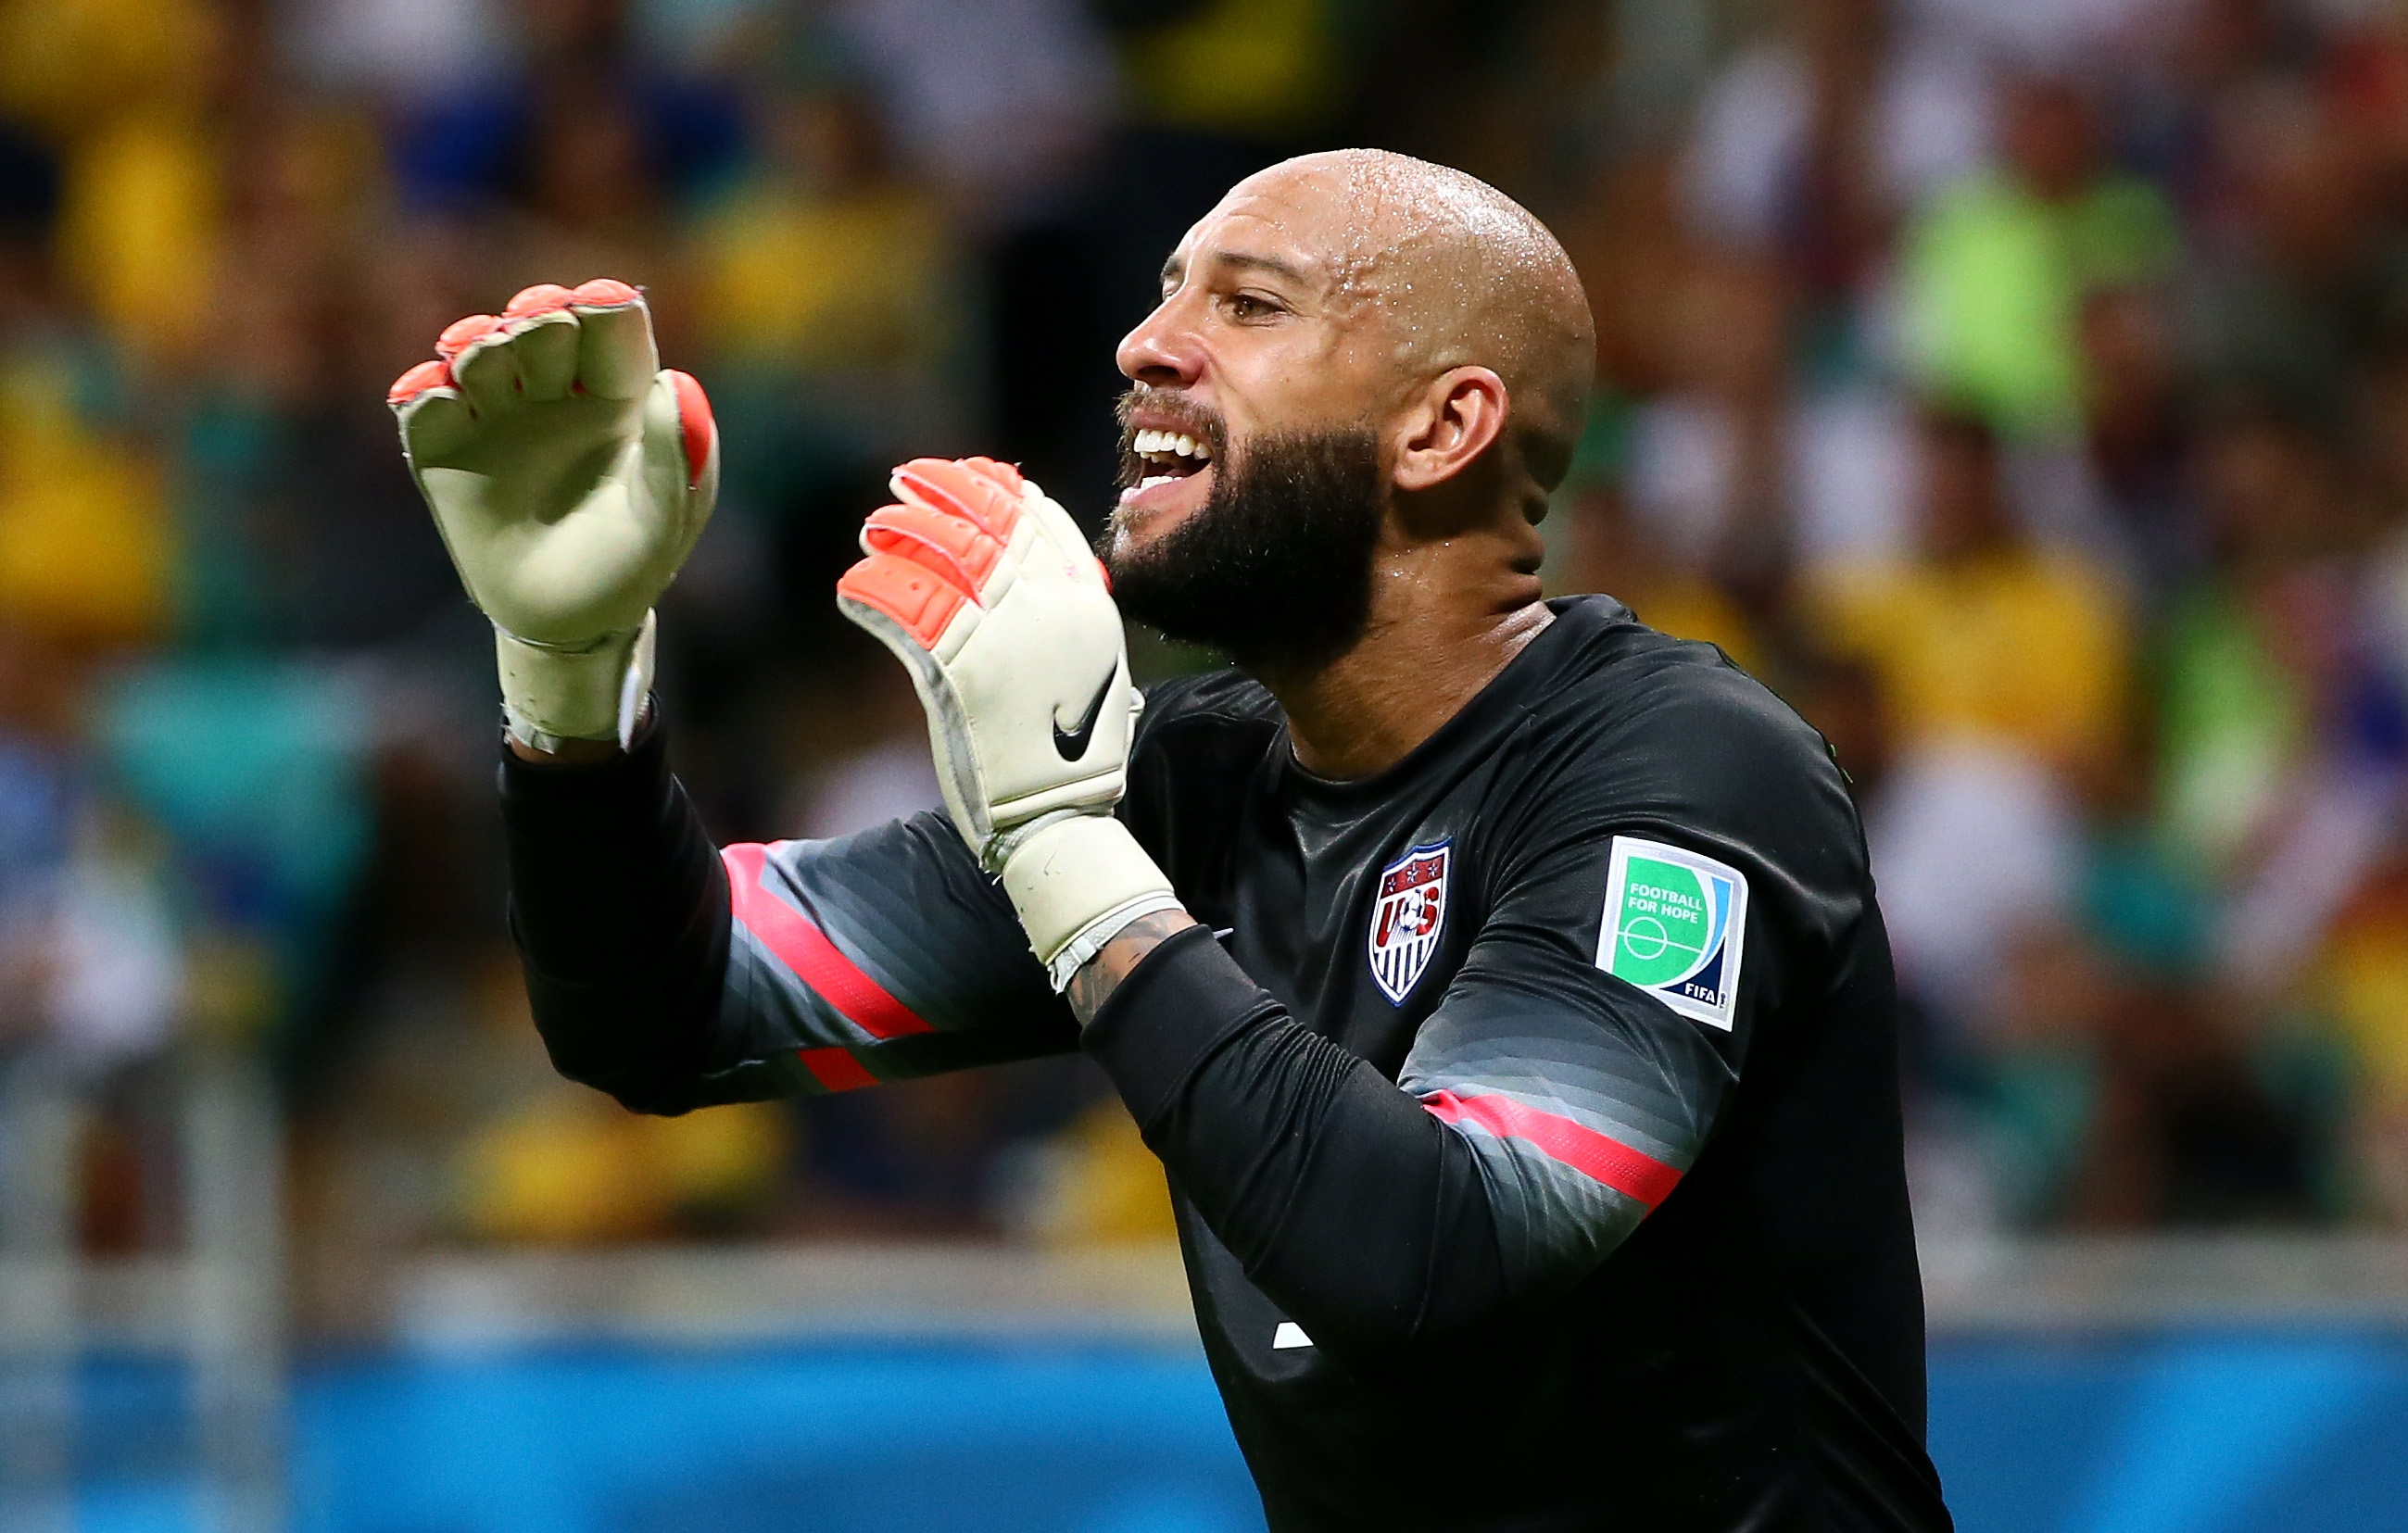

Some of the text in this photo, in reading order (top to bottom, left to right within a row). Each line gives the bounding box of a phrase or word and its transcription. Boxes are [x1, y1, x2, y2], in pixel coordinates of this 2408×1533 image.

[1630, 882, 1703, 911] FOOTBALL
[1628, 897, 1699, 924] FOR HOPE
[1684, 982, 1716, 1003] FIFA
